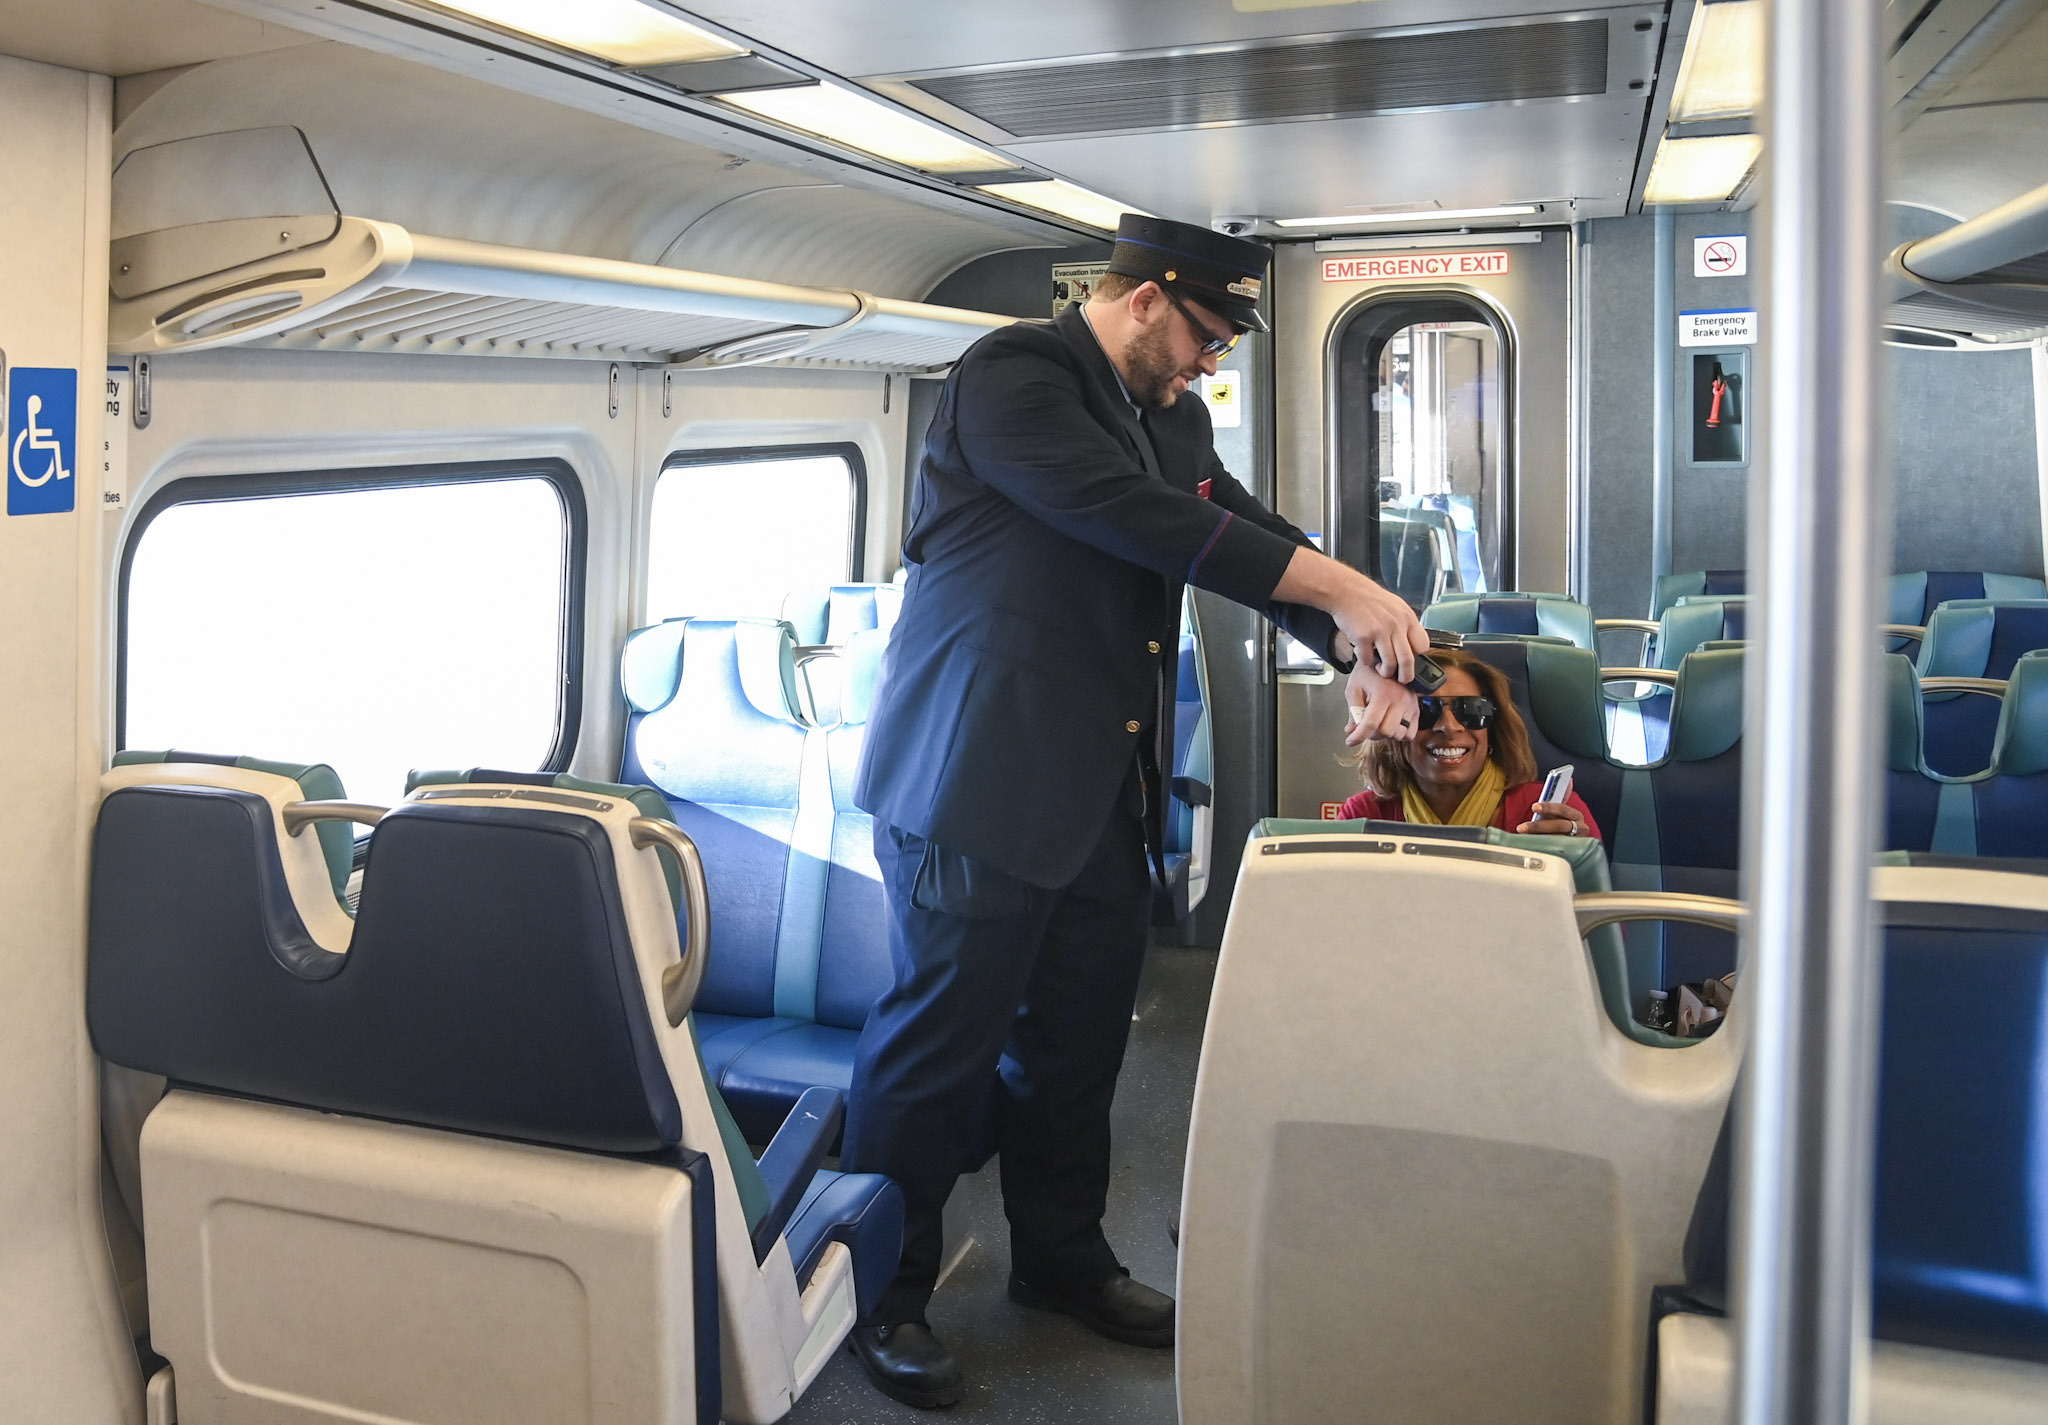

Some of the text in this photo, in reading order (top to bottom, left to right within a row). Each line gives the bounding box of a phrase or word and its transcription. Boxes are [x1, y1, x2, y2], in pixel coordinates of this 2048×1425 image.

[1325, 256, 1505, 278] EMERGENCY EXIT
[1054, 269, 1089, 277] Evacuation
[1694, 316, 1746, 326] Emergency
[1692, 327, 1748, 337] Brake Valve
